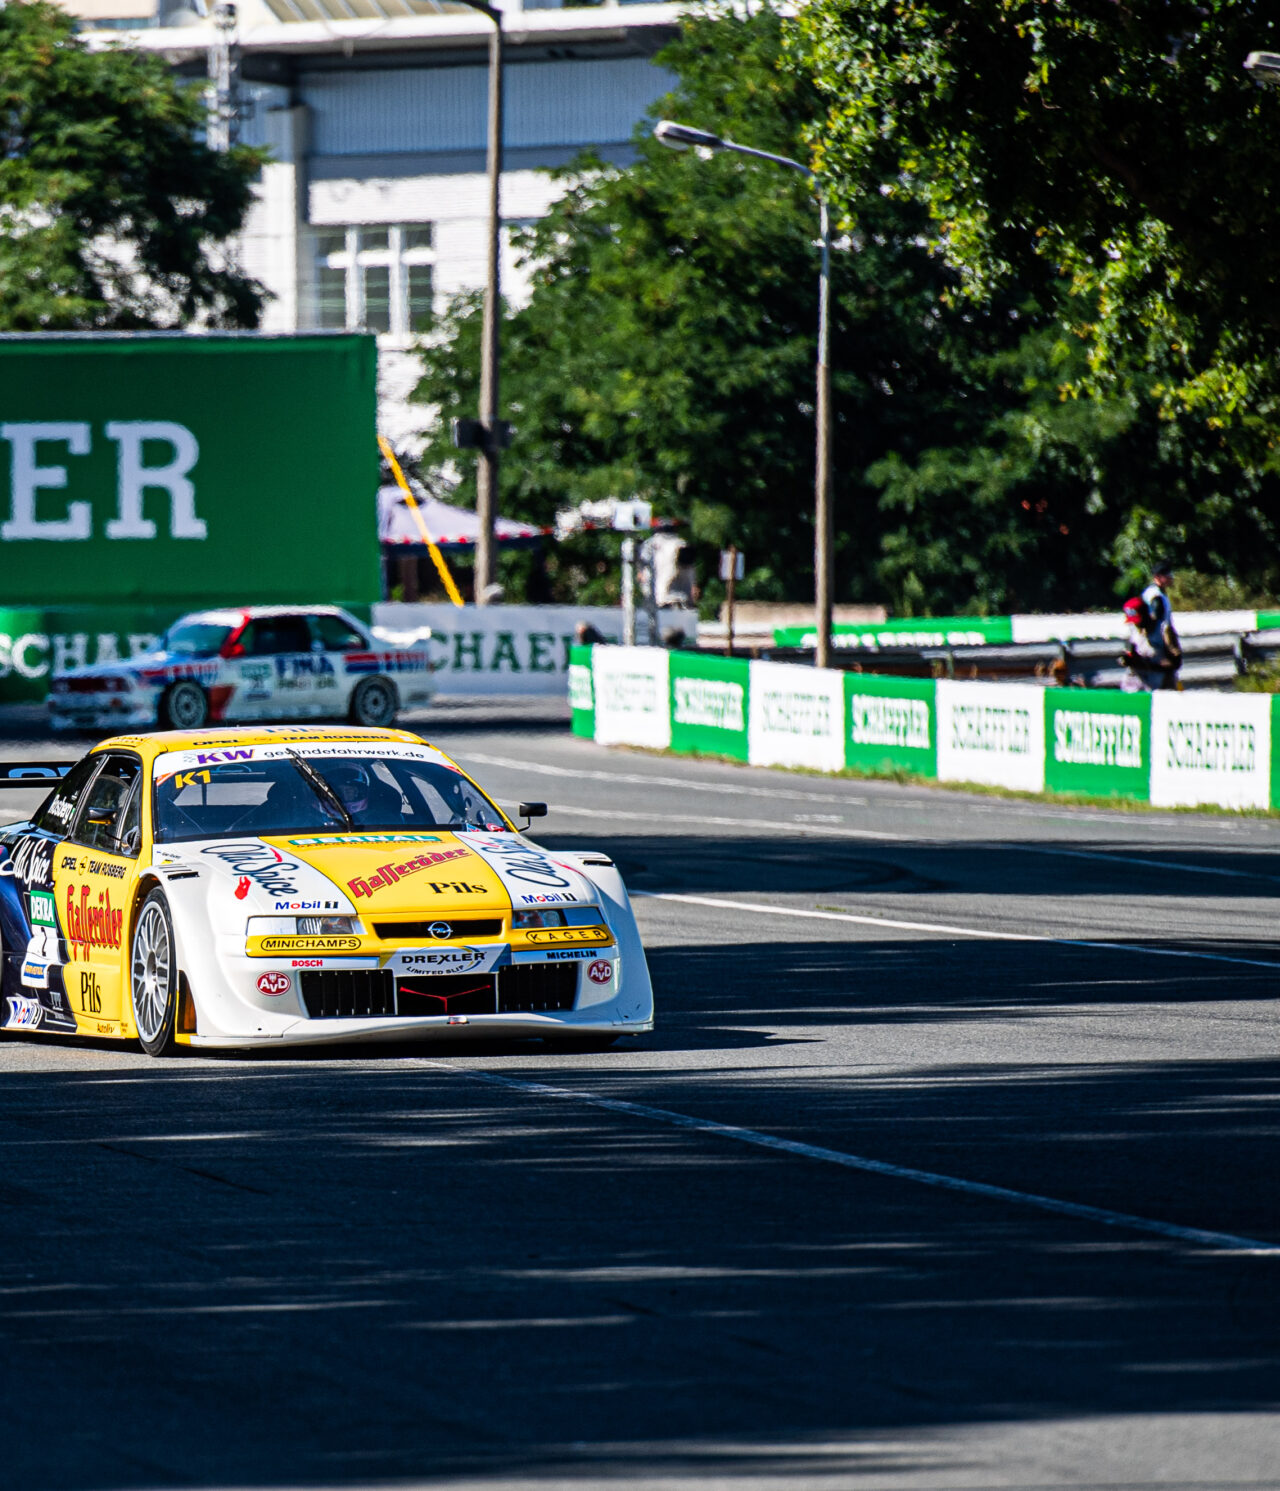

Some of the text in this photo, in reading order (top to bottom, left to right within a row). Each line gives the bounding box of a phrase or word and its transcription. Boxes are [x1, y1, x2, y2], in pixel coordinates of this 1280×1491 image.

[1054, 709, 1142, 768] SCHAEFFLER
[196, 749, 256, 765] KW
[175, 770, 211, 789] K1
[61, 856, 127, 879] OPEL TEAM ROSBERG
[200, 844, 299, 897] Old Spice
[428, 882, 488, 894] Pils
[521, 892, 562, 904] Mobil
[31, 896, 54, 922] DEKRA
[275, 901, 320, 910] Mobil
[530, 930, 608, 942] KAGER
[266, 937, 358, 949] MINICHAMPS
[402, 952, 485, 965] DREXLER
[547, 950, 597, 960] MICHELIN
[291, 960, 323, 968] BOSCH
[406, 965, 465, 975] LIMITED SLIP
[80, 972, 102, 1013] Pils
[12, 1000, 35, 1024] Mobil
